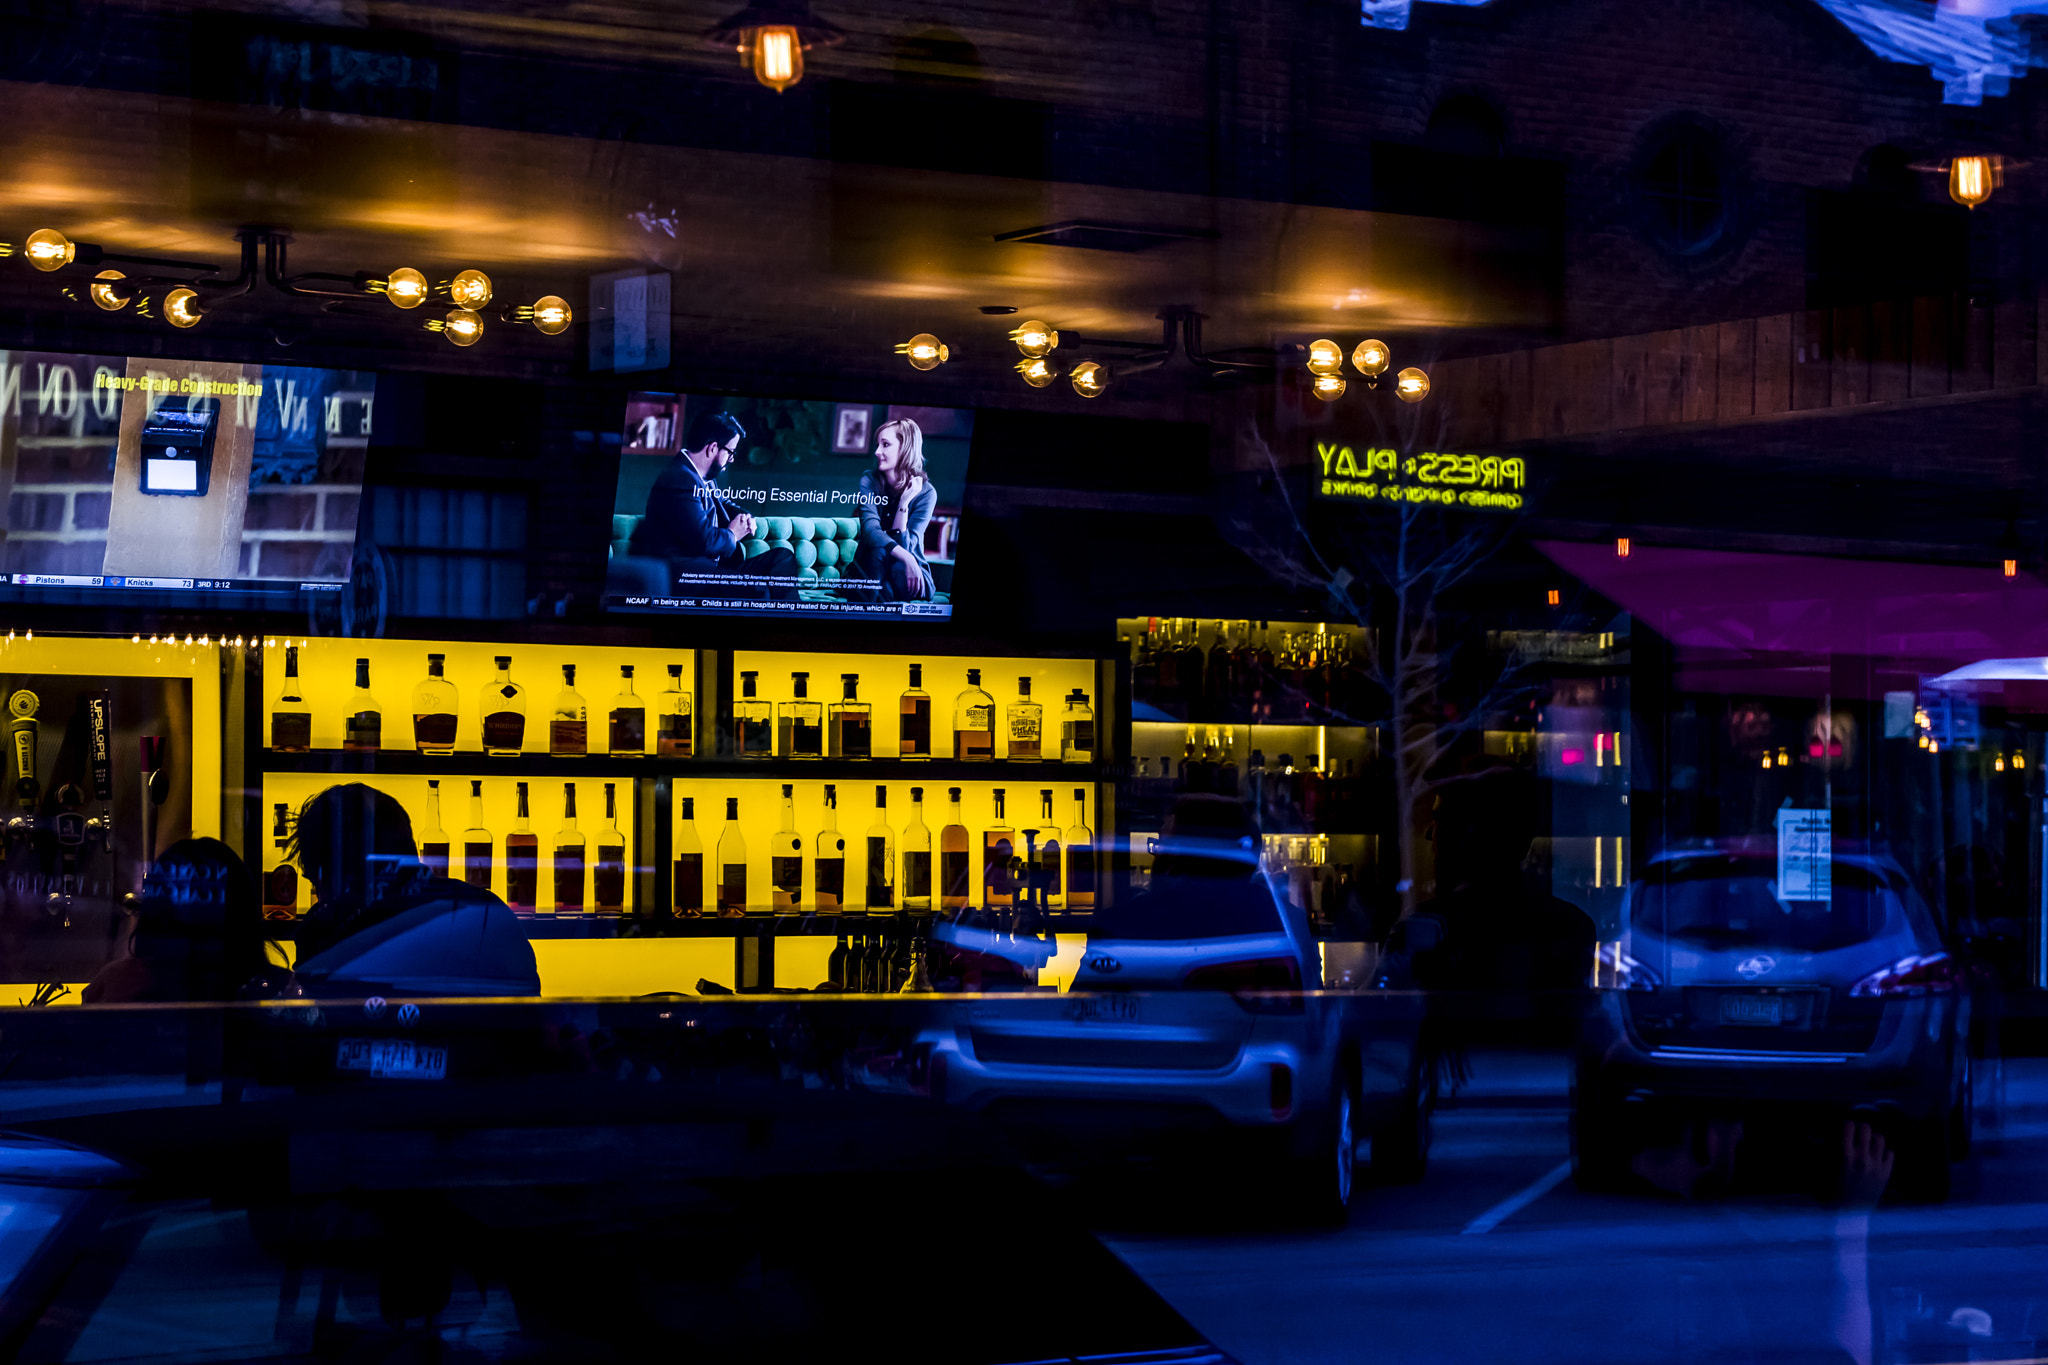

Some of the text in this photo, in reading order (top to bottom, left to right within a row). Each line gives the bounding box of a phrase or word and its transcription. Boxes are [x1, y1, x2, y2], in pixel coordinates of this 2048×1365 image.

[95, 373, 263, 397] Heavy-Grade Construction
[693, 484, 889, 506] Introducing Essential Portfolios
[35, 576, 102, 585] Pistons 59
[127, 579, 192, 588] Knicks 73
[214, 581, 230, 589] 9:12
[625, 597, 650, 605] NCAAF
[660, 599, 679, 607] being
[702, 599, 723, 607] Childs
[751, 601, 776, 609] hospital
[777, 602, 795, 610] being
[797, 602, 819, 610] treated
[841, 604, 865, 612] injuries,
[93, 698, 107, 761] UPSLOPE
